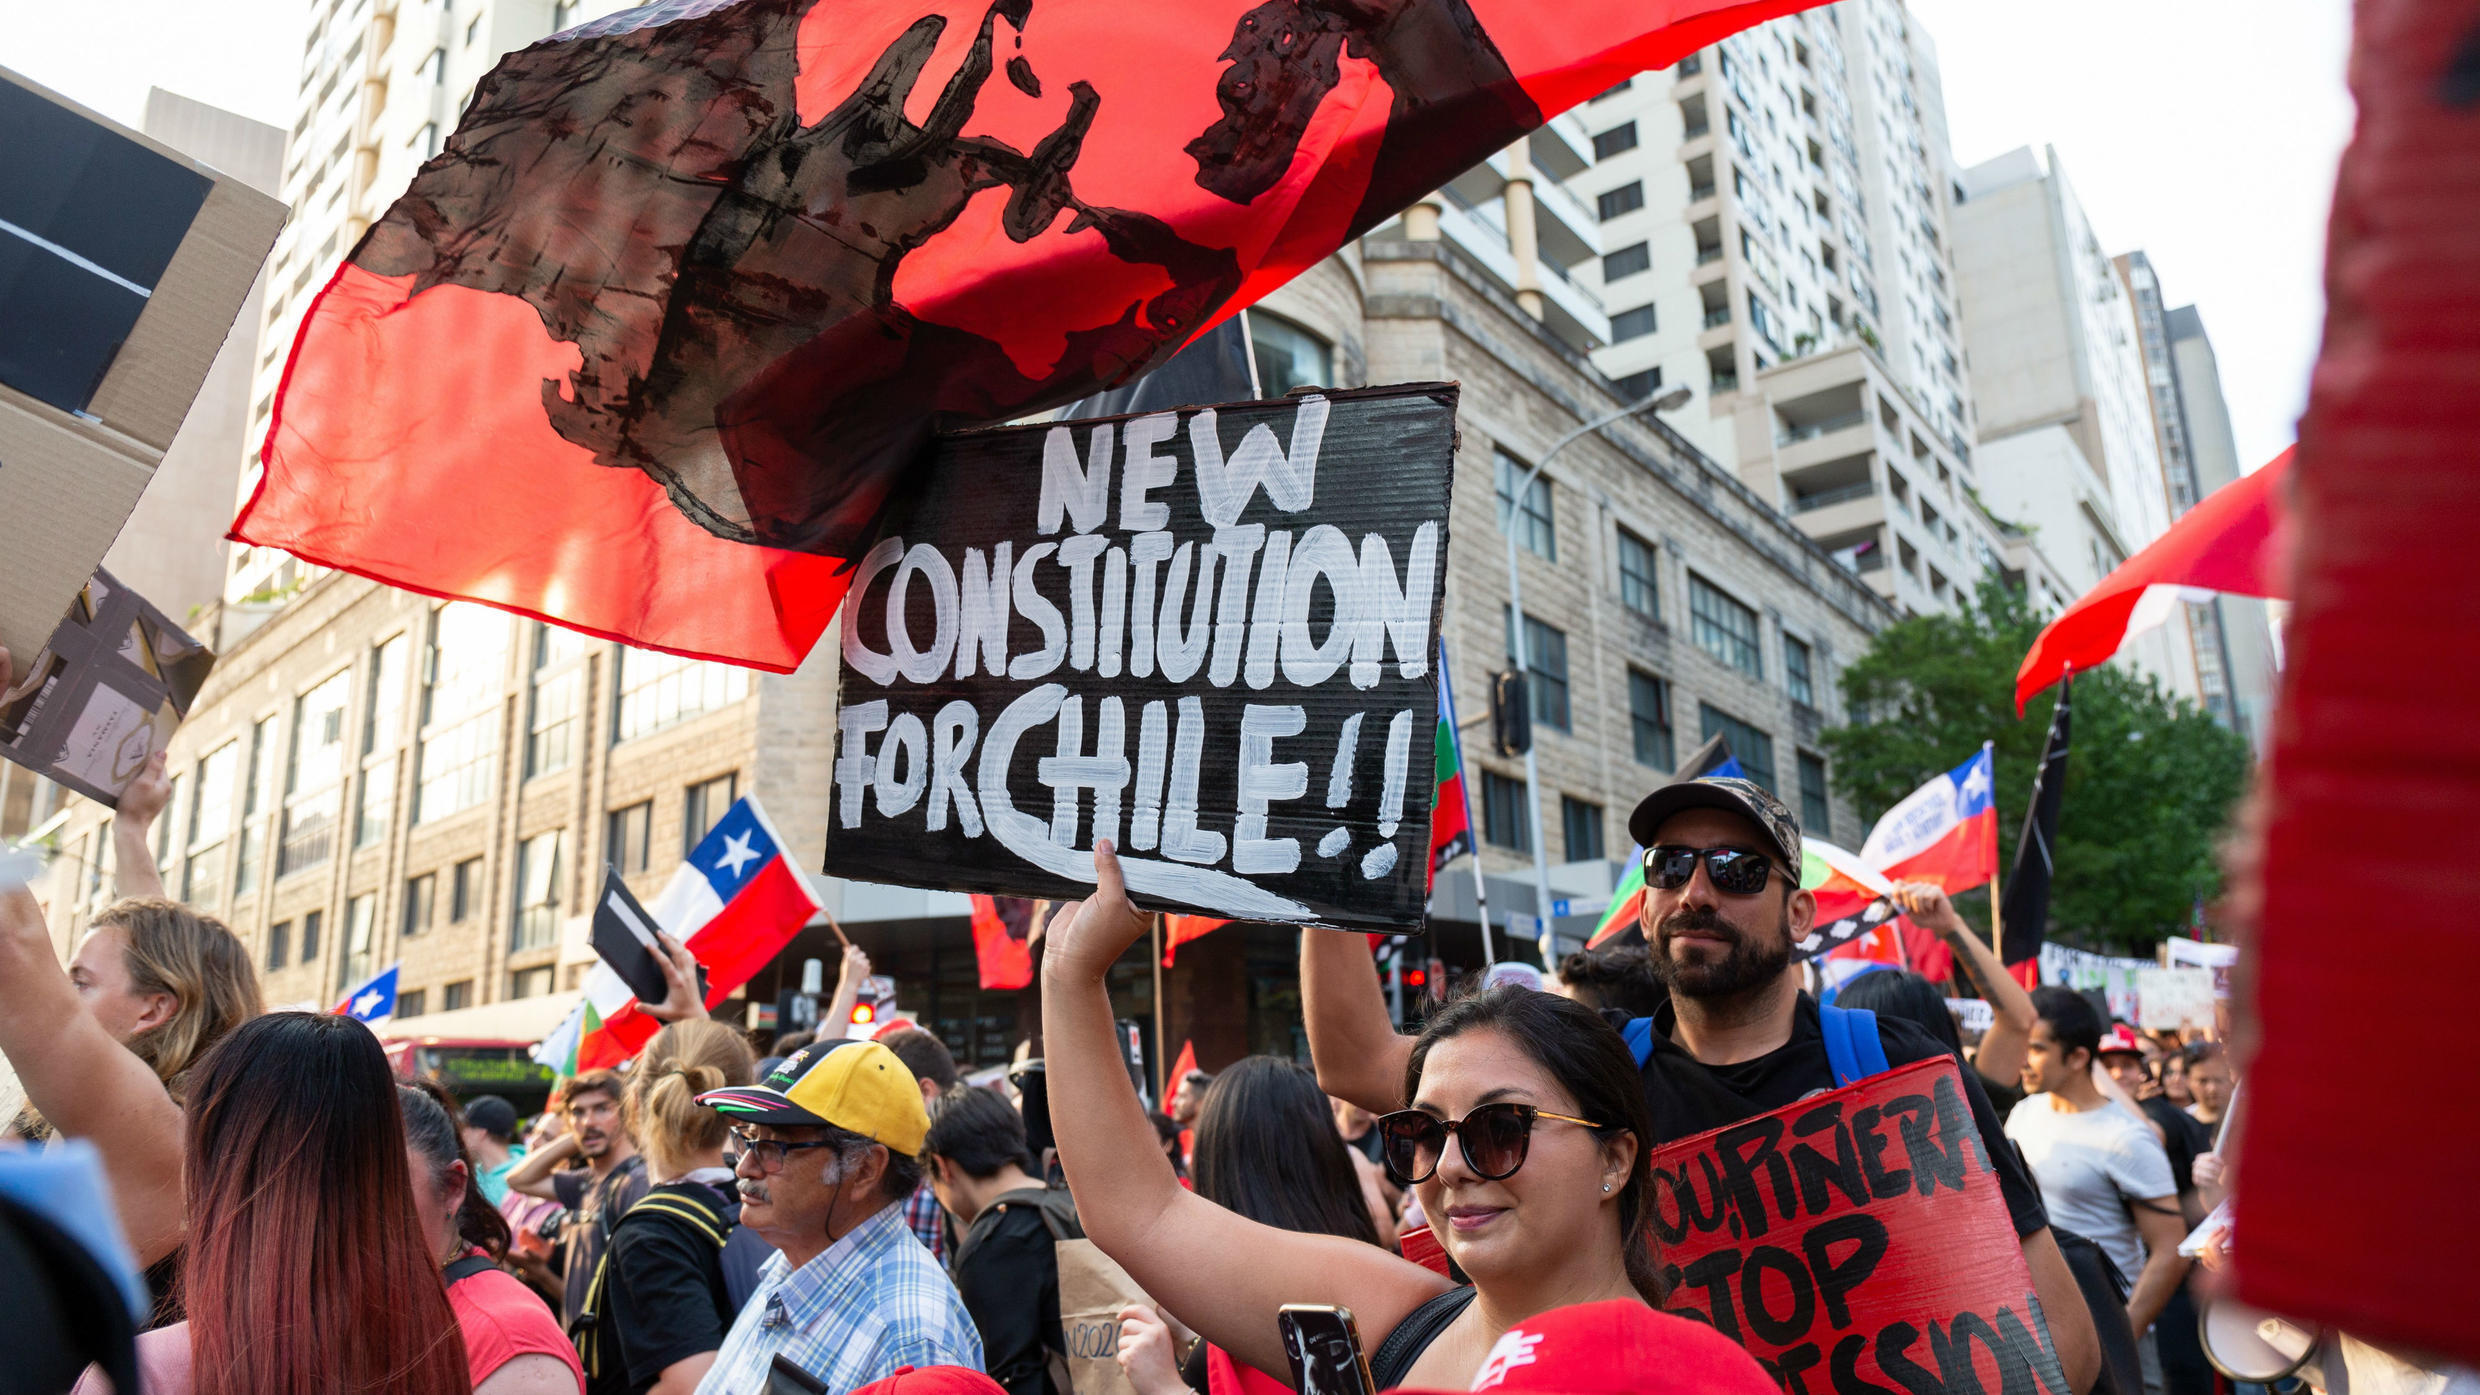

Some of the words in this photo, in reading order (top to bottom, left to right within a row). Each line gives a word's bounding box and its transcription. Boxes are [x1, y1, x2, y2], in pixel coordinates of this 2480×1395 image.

[1037, 394, 1331, 530] NEW
[842, 520, 1439, 691] CONSTITUTION
[835, 698, 984, 839] FOR
[978, 682, 1413, 922] CHILE!!
